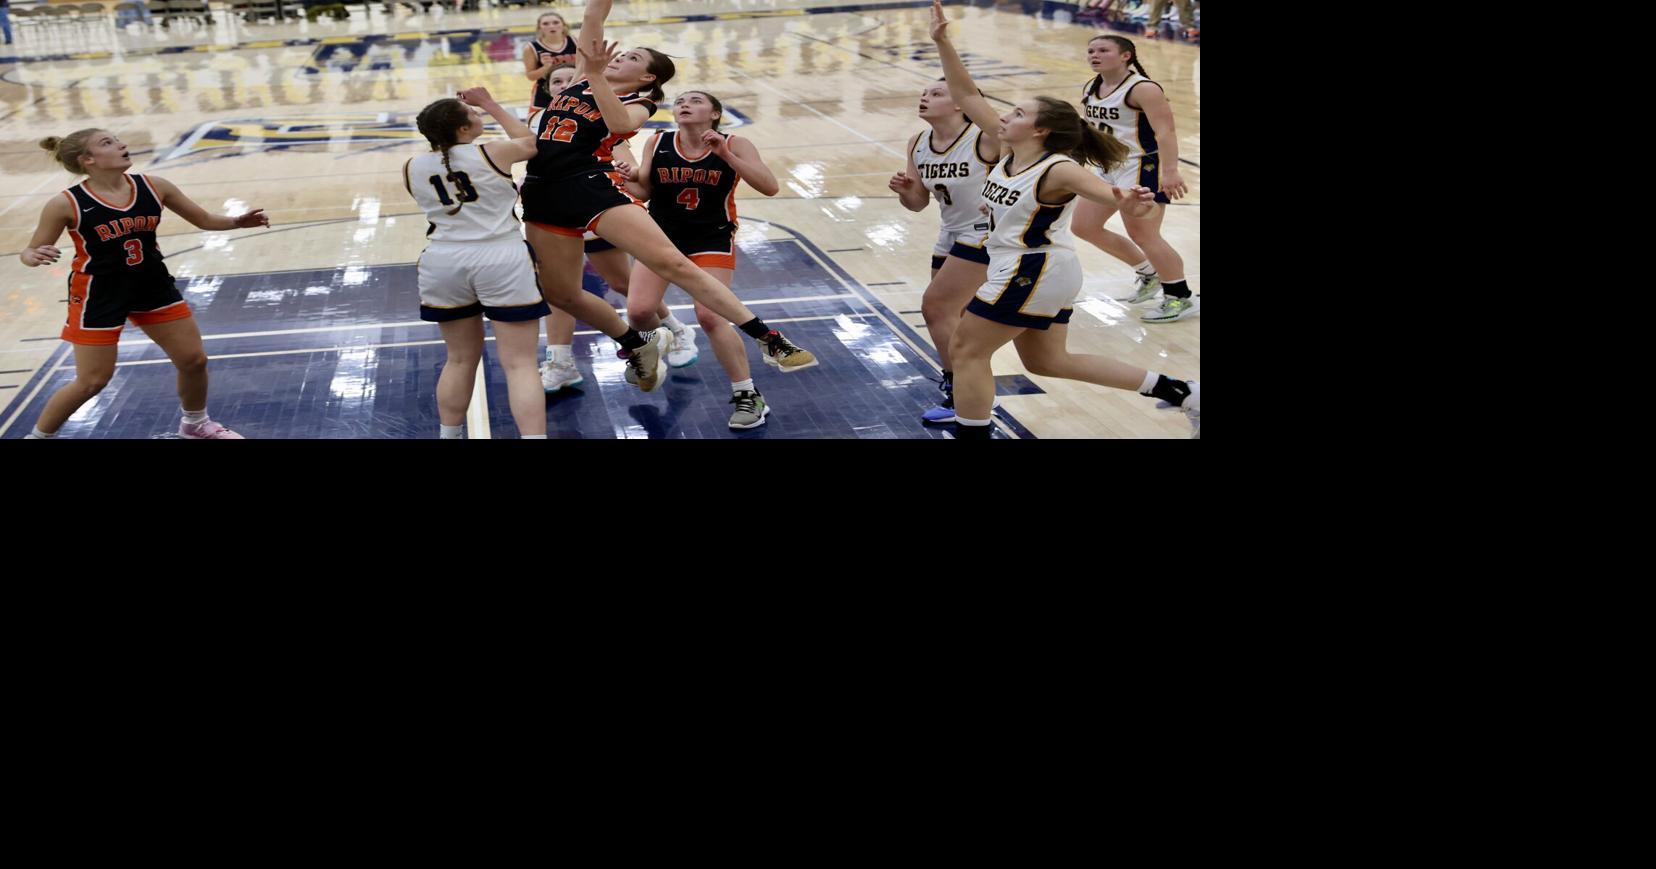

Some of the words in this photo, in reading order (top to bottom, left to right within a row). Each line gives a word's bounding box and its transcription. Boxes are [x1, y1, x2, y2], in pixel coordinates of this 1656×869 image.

[539, 116, 578, 143] 12
[657, 167, 722, 186] RIPON
[918, 162, 970, 179] TIGERS
[429, 171, 479, 206] 13
[676, 187, 701, 211] 4
[981, 179, 1021, 207] IGERS
[94, 215, 159, 242] RIPON
[123, 238, 144, 267] 3
